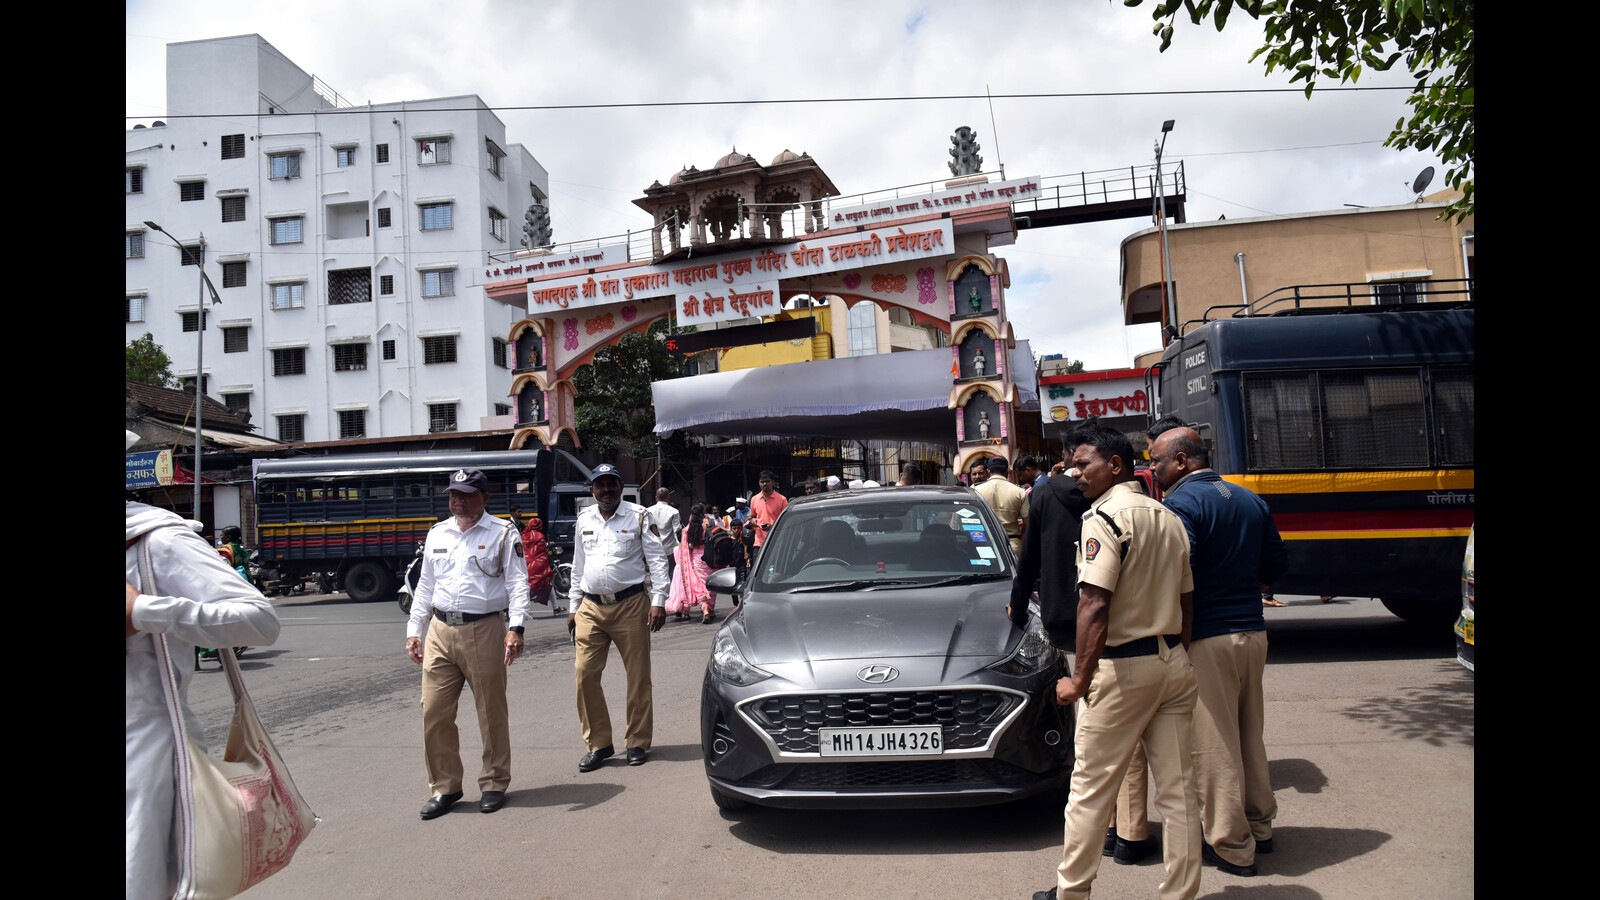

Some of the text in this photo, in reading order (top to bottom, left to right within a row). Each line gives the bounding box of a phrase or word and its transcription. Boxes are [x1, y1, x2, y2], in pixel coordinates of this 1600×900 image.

[582, 277, 596, 298] श्री
[599, 274, 619, 296] संत
[622, 271, 669, 299] तुकाराम
[672, 263, 718, 286] महाराज
[721, 258, 752, 284] मुख्य
[755, 248, 788, 272] मंदिर
[827, 233, 881, 262] टाळकरी
[885, 228, 944, 253] प्रवेशद्वार
[683, 285, 774, 317] श्री क्षेत्र देहूगांव
[1185, 351, 1205, 369] POLICE
[1188, 375, 1206, 395] SML
[1427, 491, 1467, 504] पोलीस
[833, 732, 940, 751] MH14JH4326
